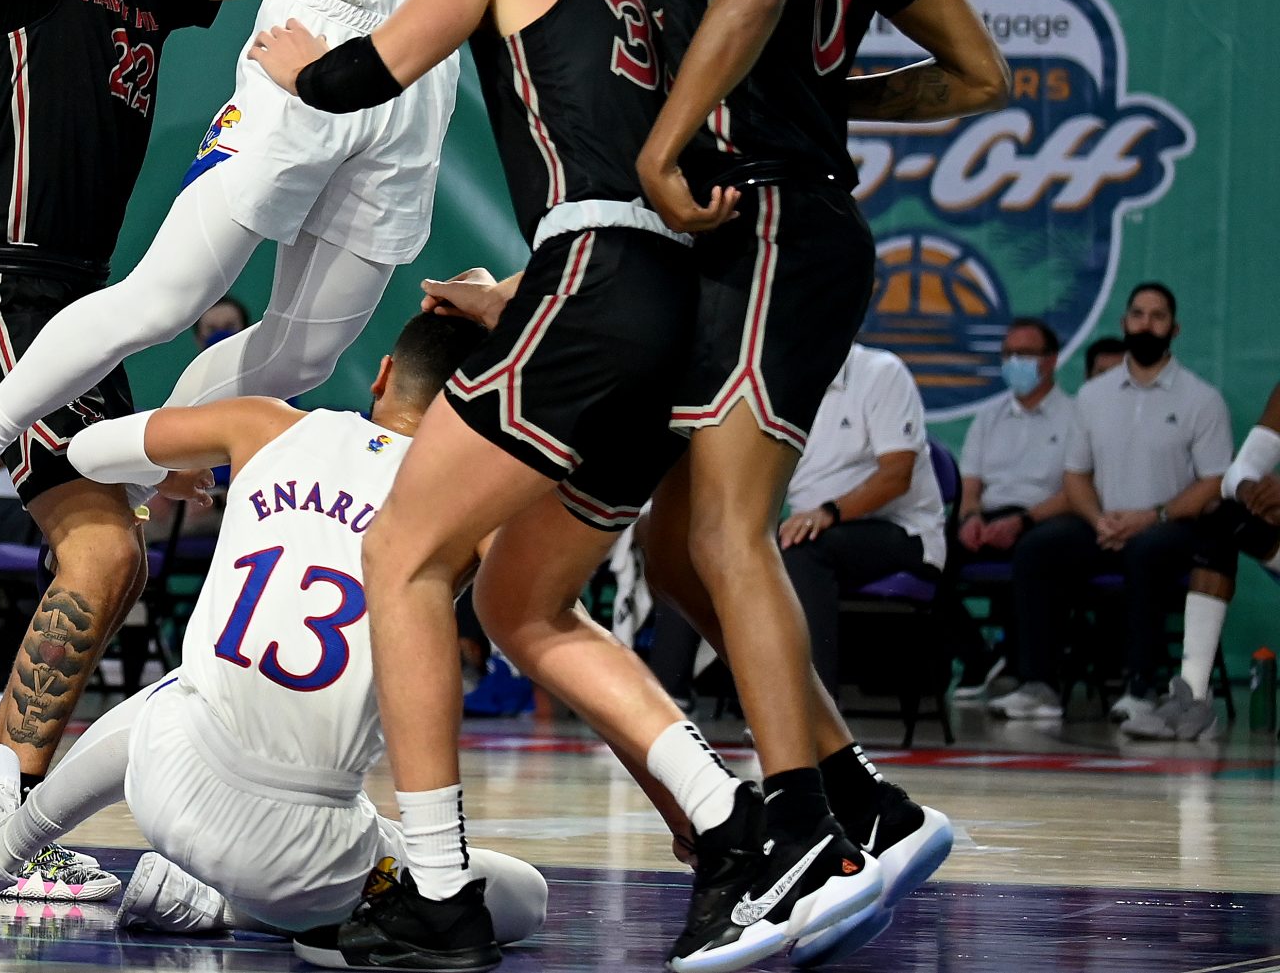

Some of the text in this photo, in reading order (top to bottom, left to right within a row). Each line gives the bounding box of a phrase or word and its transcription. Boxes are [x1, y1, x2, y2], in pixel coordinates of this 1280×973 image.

[982, 10, 1070, 45] tgage
[108, 27, 155, 118] 22
[248, 479, 380, 534] ENARU
[214, 545, 369, 693] 13
